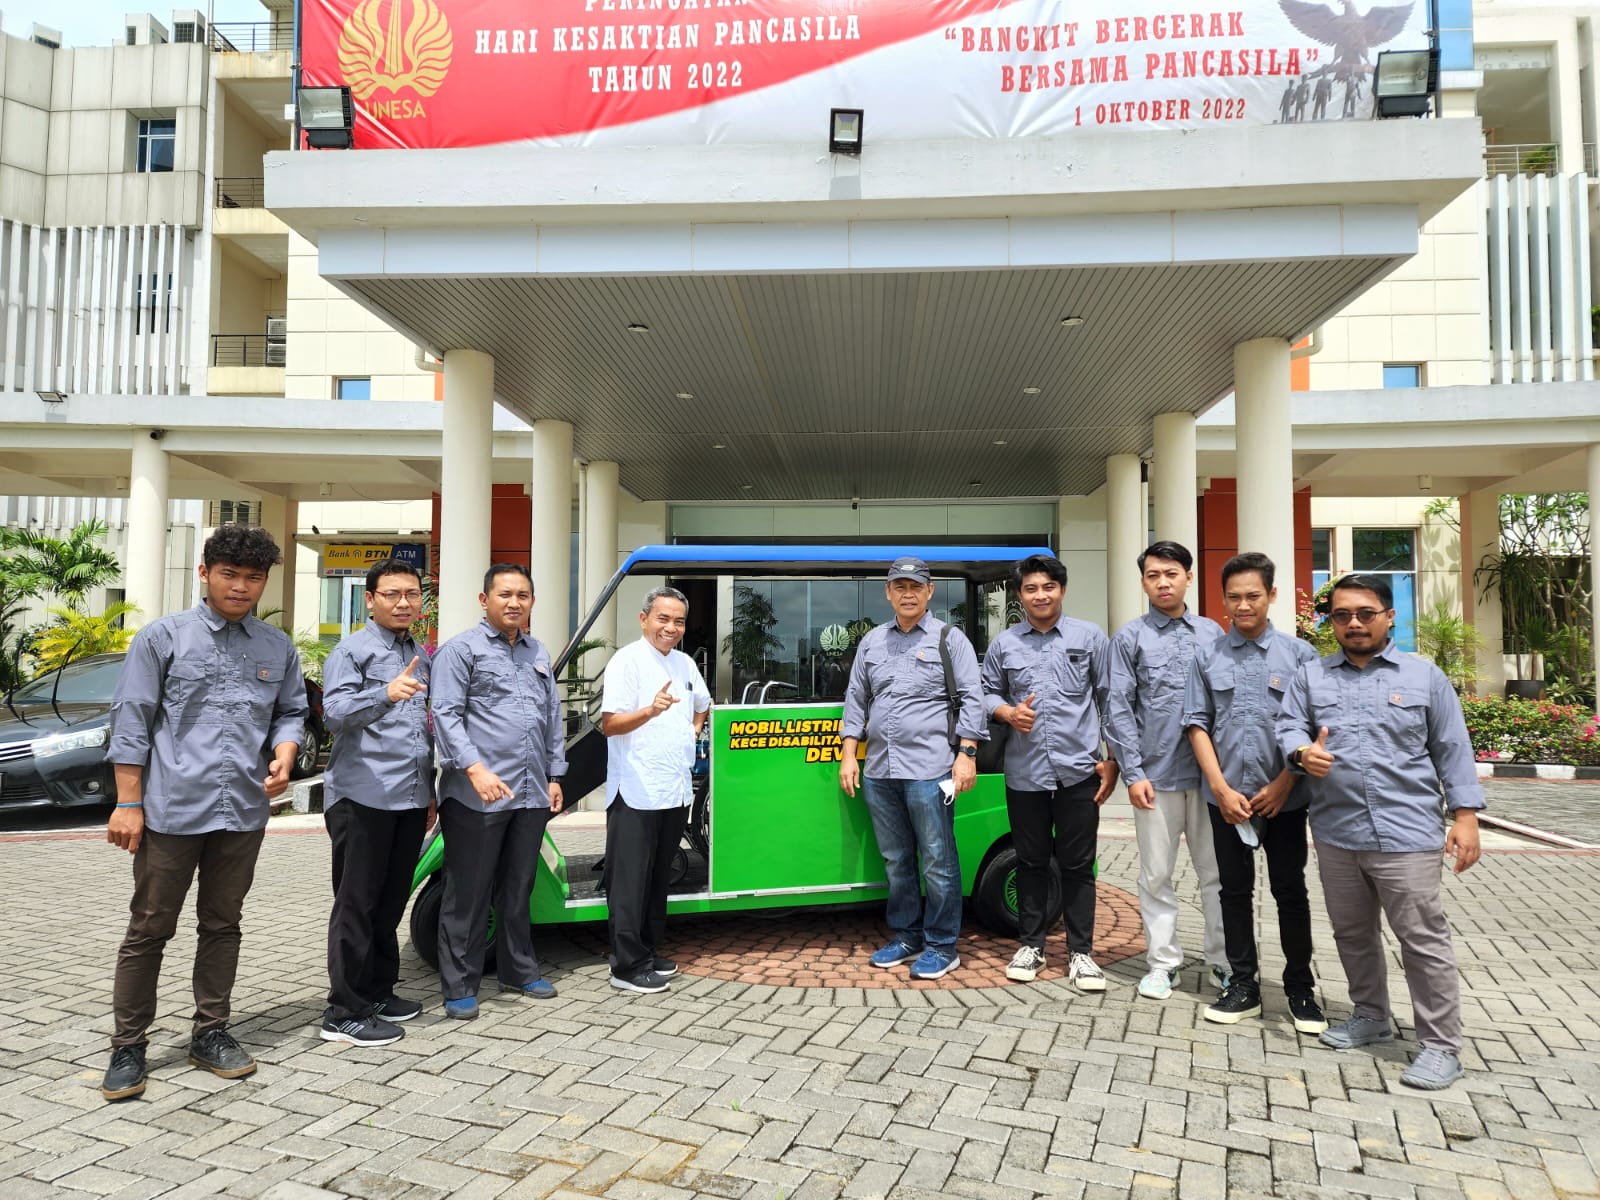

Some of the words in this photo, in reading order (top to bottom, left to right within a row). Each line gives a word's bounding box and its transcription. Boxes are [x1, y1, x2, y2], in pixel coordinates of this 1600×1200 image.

[474, 28, 538, 54] HARI
[552, 23, 700, 52] KESAKTIAN
[714, 14, 860, 46] PANCASILA
[1096, 12, 1244, 44] BERGERAK
[588, 64, 672, 93] TAHUN
[687, 61, 742, 89] 2022
[1001, 54, 1129, 93] BERSAMA
[365, 100, 427, 119] UNESA
[1073, 106, 1082, 127] 1
[1095, 98, 1191, 125] OKTOBER
[1202, 98, 1246, 120] 2022
[328, 549, 350, 558] Bank
[365, 550, 390, 558] BTN
[395, 550, 416, 559] ATM
[729, 720, 784, 736] MOBIL
[785, 719, 843, 734] LISTRI
[729, 736, 767, 750] KECE
[767, 734, 842, 748] DISABILITA
[805, 746, 845, 762] DEV
